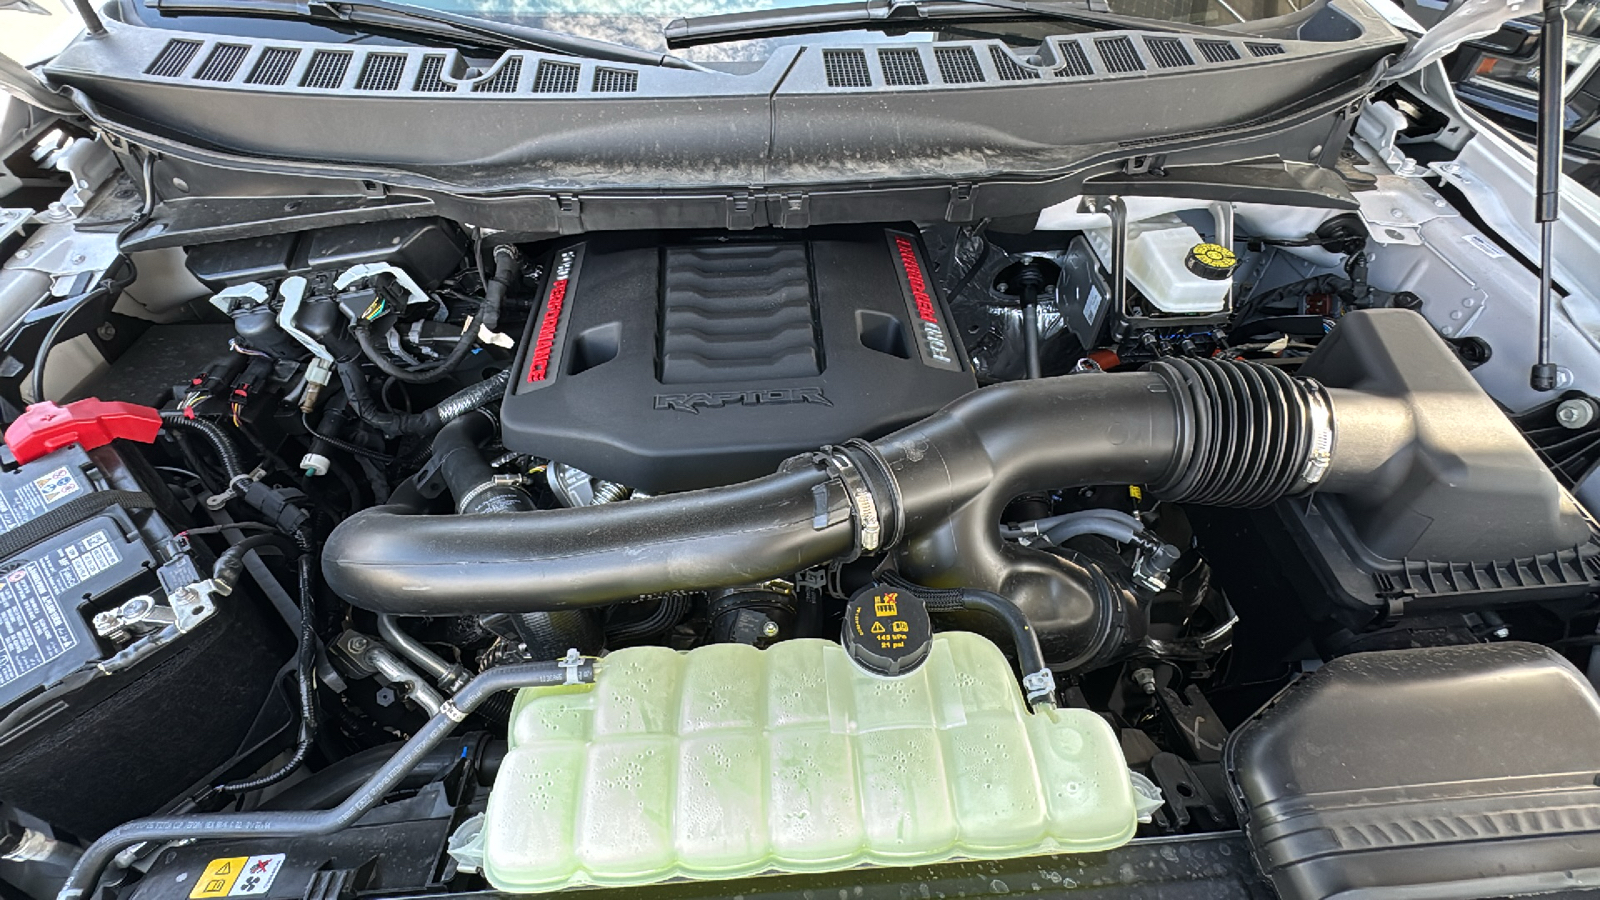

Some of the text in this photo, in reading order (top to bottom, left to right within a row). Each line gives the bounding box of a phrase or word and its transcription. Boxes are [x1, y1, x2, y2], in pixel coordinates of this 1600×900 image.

[527, 279, 569, 383] PERFORMANCE
[924, 322, 951, 363] FORD
[653, 386, 834, 415] RAPTOR
